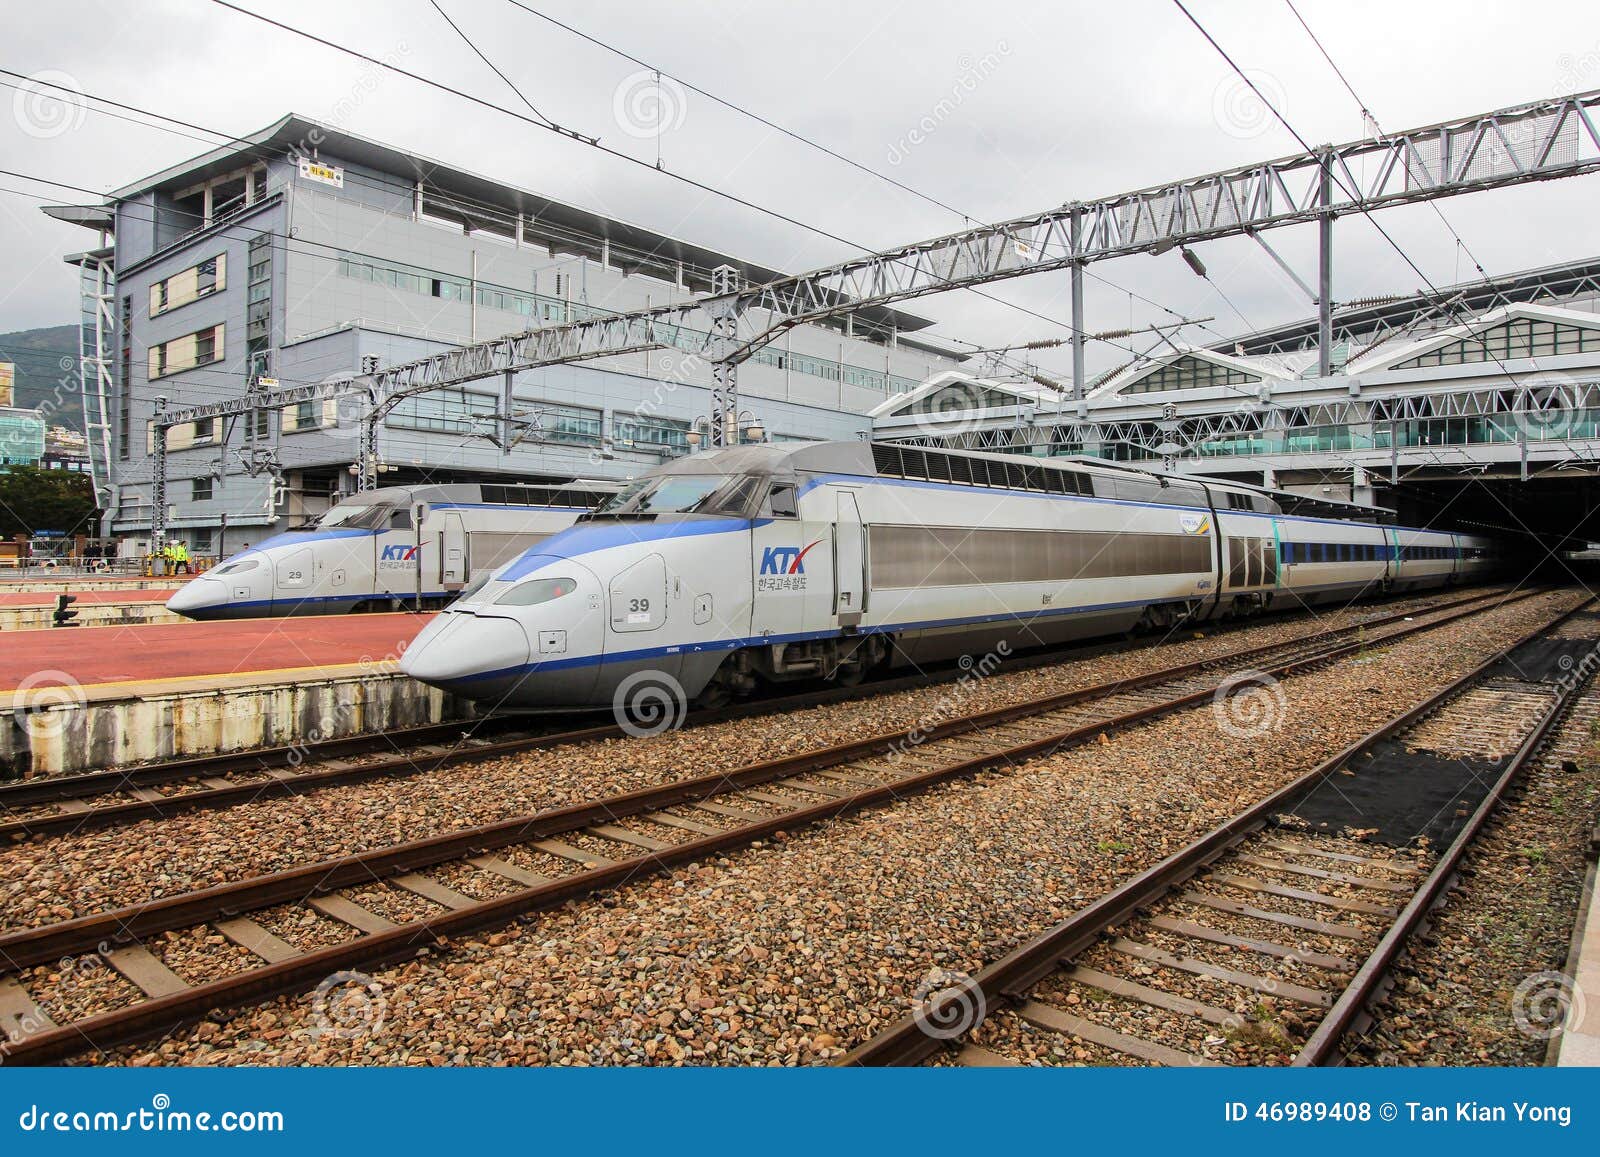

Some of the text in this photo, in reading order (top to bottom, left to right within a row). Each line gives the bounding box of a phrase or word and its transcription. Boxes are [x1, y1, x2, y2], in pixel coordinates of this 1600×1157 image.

[381, 542, 427, 560] KTX
[760, 541, 820, 574] KTX
[289, 571, 302, 579] 29
[758, 577, 808, 592] 한국고속철도
[629, 598, 650, 612] 39
